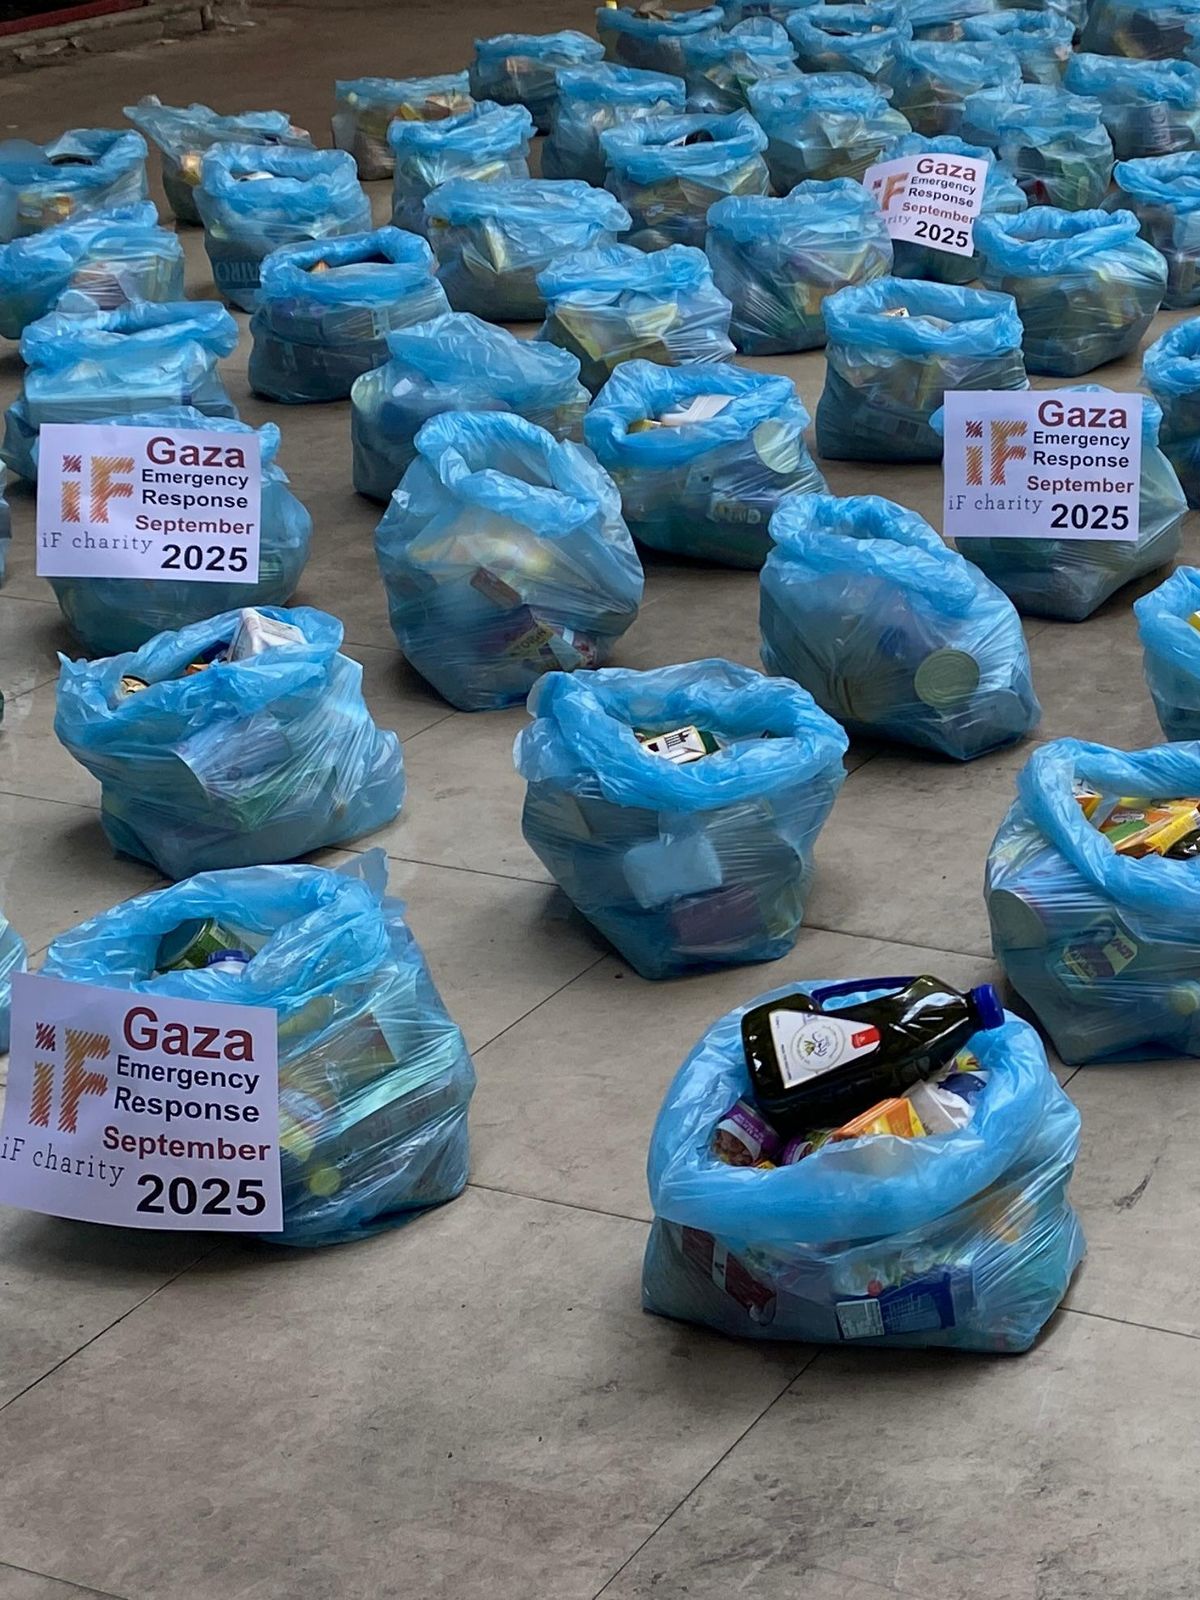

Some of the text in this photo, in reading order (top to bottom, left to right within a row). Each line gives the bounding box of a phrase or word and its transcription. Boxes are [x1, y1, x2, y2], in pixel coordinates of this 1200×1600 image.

[916, 158, 976, 181] Gaza
[908, 187, 974, 207] Response
[911, 176, 976, 195] Emergency
[902, 202, 974, 224] September
[914, 221, 969, 247] 2025
[1038, 400, 1127, 429] Gaza
[1033, 431, 1130, 449] Emergency
[146, 436, 245, 468] Gaza
[1033, 451, 1129, 469] Response
[142, 469, 249, 489] Emergency
[1027, 476, 1135, 494] September
[142, 489, 248, 508] Response
[949, 493, 1043, 513] iF charity
[135, 515, 254, 535] September
[1050, 503, 1129, 530] 2025
[42, 532, 153, 554] iF charity
[161, 544, 248, 572] 2025
[123, 1006, 254, 1062] Gaza
[117, 1054, 260, 1094] Emergency
[114, 1086, 260, 1122] Response
[103, 1125, 271, 1161] September
[1, 1136, 125, 1187] iF charity
[136, 1174, 266, 1216] 2025
